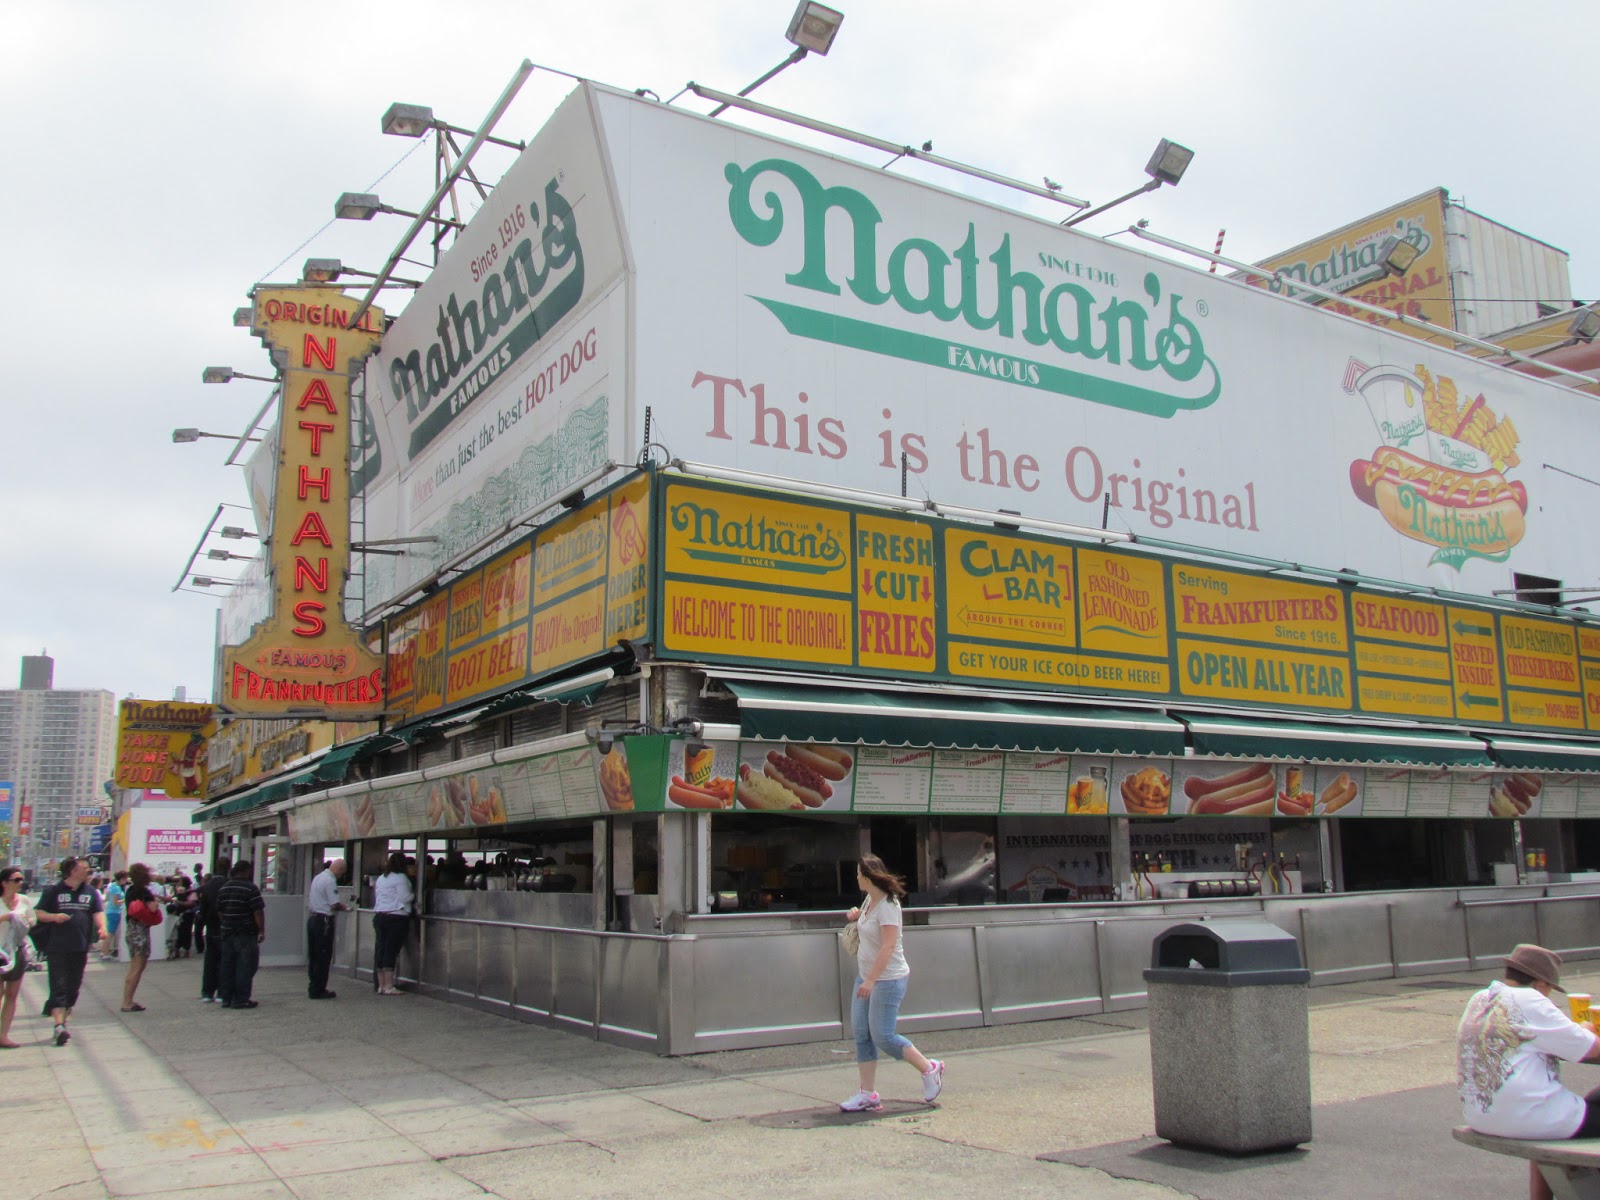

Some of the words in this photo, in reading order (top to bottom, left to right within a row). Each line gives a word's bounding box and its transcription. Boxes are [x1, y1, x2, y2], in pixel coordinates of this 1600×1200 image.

[471, 246, 499, 283] Since
[499, 204, 527, 250] 1916
[724, 158, 1209, 384] Nathan's
[1038, 251, 1085, 281] SINCE
[1086, 265, 1120, 288] 1916
[265, 299, 380, 332] ORIGINL
[391, 176, 583, 425] Nathan's
[449, 341, 513, 416] FAMOUS
[946, 344, 1041, 386] FAMOUS
[434, 456, 457, 490] than
[457, 438, 479, 477] just
[479, 423, 496, 451] the
[497, 398, 523, 436] best
[524, 369, 556, 416] HOT
[558, 326, 598, 386] DOG
[690, 370, 849, 460] This
[878, 408, 930, 475] is
[955, 427, 1041, 493] the
[1064, 445, 1262, 533] Original
[670, 502, 842, 562] Nathan's
[858, 529, 933, 568] FRESH
[741, 556, 776, 569] FAMOUS
[960, 540, 1055, 578] CLAM
[1105, 559, 1130, 583] OLD
[609, 563, 646, 603] ORDER
[874, 571, 920, 602] CUT
[1004, 577, 1061, 609] BAR
[1088, 574, 1151, 608] FASHIONED
[1178, 572, 1229, 596] Serving
[450, 600, 481, 642] FRIES
[608, 596, 646, 637] HERE!
[672, 596, 737, 641] WELCOME
[740, 603, 756, 642] TO
[759, 605, 783, 645] THE
[786, 608, 846, 651] ORIGINAL!
[966, 612, 1004, 625] AROUND
[1008, 616, 1025, 627] THE
[1029, 619, 1064, 631] CORNER
[1082, 592, 1160, 632] LEMONADE
[1181, 594, 1339, 625] FRANKFURTERS
[1354, 600, 1440, 638] SEAFOOD
[425, 628, 439, 654] THE
[533, 614, 563, 657] ENJOY
[562, 620, 572, 645] the
[573, 604, 603, 644] Original!
[859, 610, 935, 660] FRIES
[1274, 625, 1307, 641] Since
[1505, 625, 1524, 650] OLD
[1524, 627, 1574, 656] FASHIONED
[272, 651, 347, 671] FAMOUS
[448, 649, 486, 695] ROOT
[487, 632, 528, 680] BEER
[959, 652, 984, 668] GET
[990, 654, 1028, 673] YOUR
[1033, 659, 1053, 675] ICE
[1057, 661, 1090, 678] COLD
[1094, 665, 1123, 681] BEER
[1127, 669, 1161, 685] HERE!
[1453, 643, 1494, 665] SERVED
[1507, 654, 1575, 682] CHEESEBURGERS
[231, 662, 385, 705] FRANKFURTERS
[1187, 651, 1249, 690] OPEN
[1253, 658, 1290, 693] ALL
[1290, 661, 1345, 698] YEAR
[1457, 665, 1496, 687] INSIDE
[119, 751, 169, 764] HOME
[123, 733, 169, 749] TAKE
[892, 750, 931, 765] Frankfurters
[116, 766, 166, 783] FOOD
[966, 757, 987, 768] French
[1034, 755, 1069, 770] Beverages
[148, 835, 204, 843] AVAILABLE
